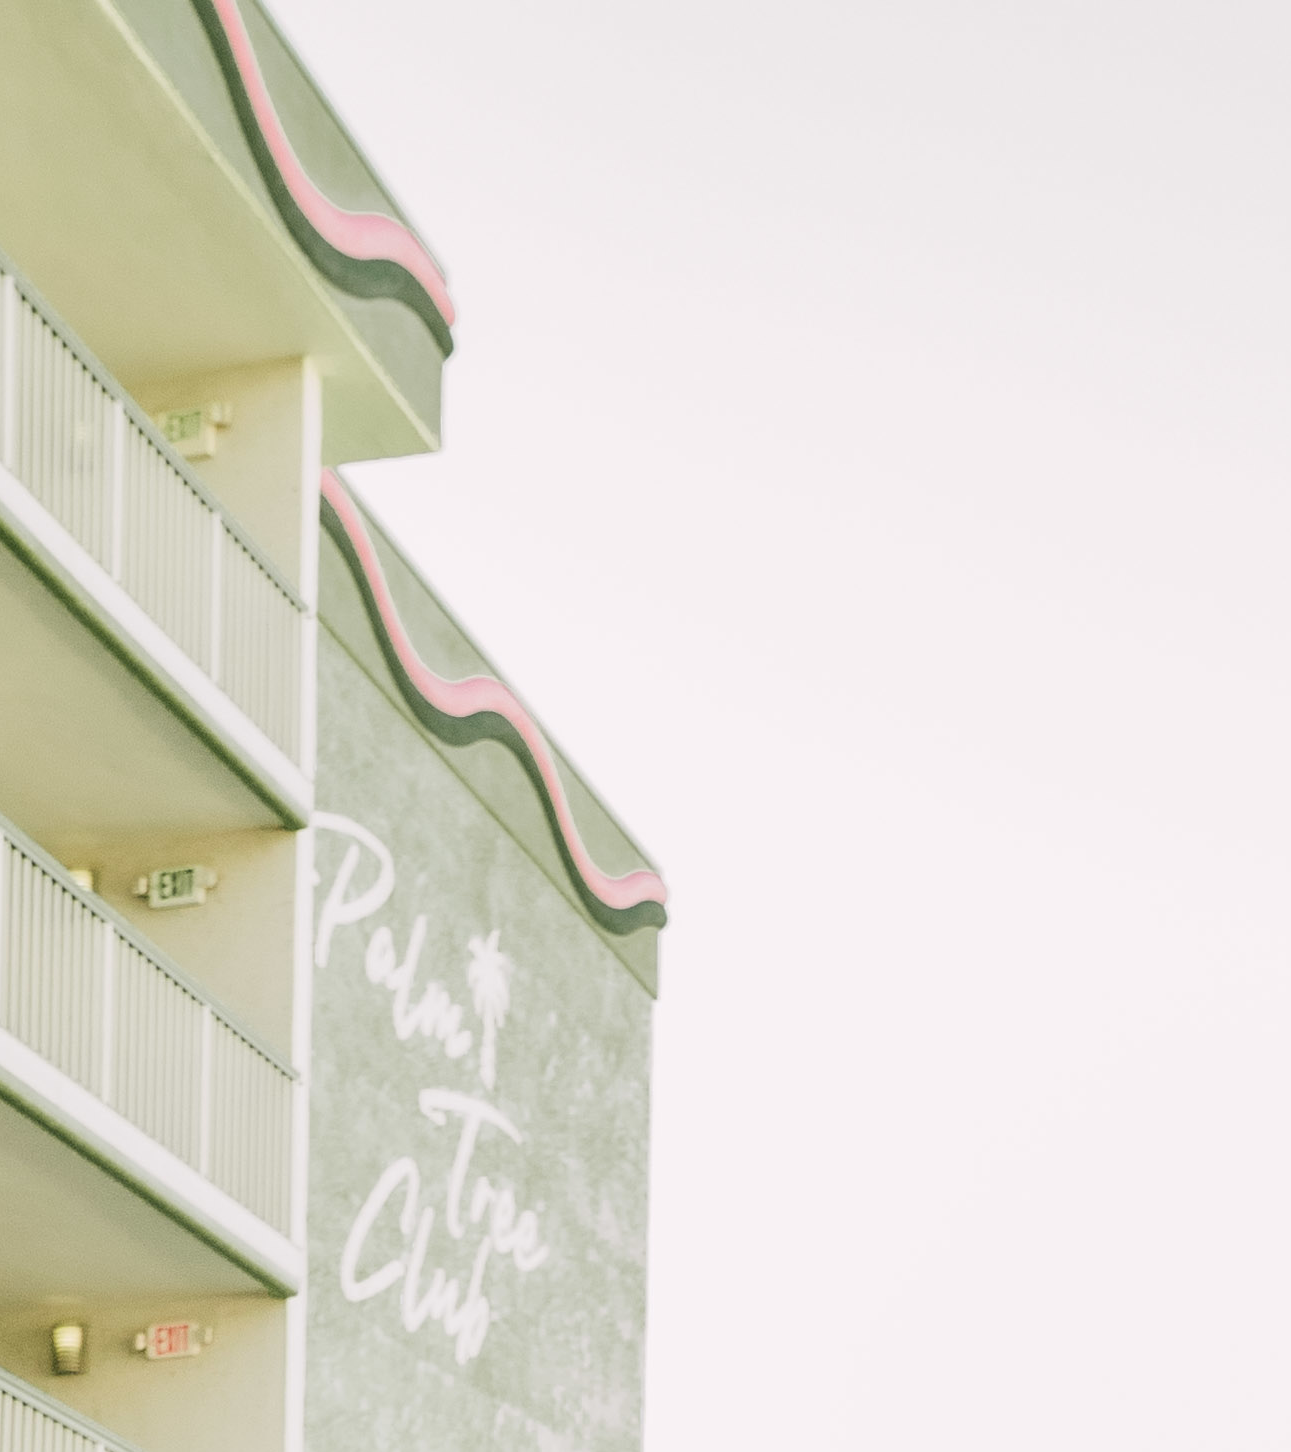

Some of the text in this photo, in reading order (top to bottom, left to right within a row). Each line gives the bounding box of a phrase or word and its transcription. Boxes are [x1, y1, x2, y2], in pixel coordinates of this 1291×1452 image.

[308, 811, 472, 1058] Palm
[341, 1155, 491, 1366] Club
[418, 1087, 550, 1272] Tree
